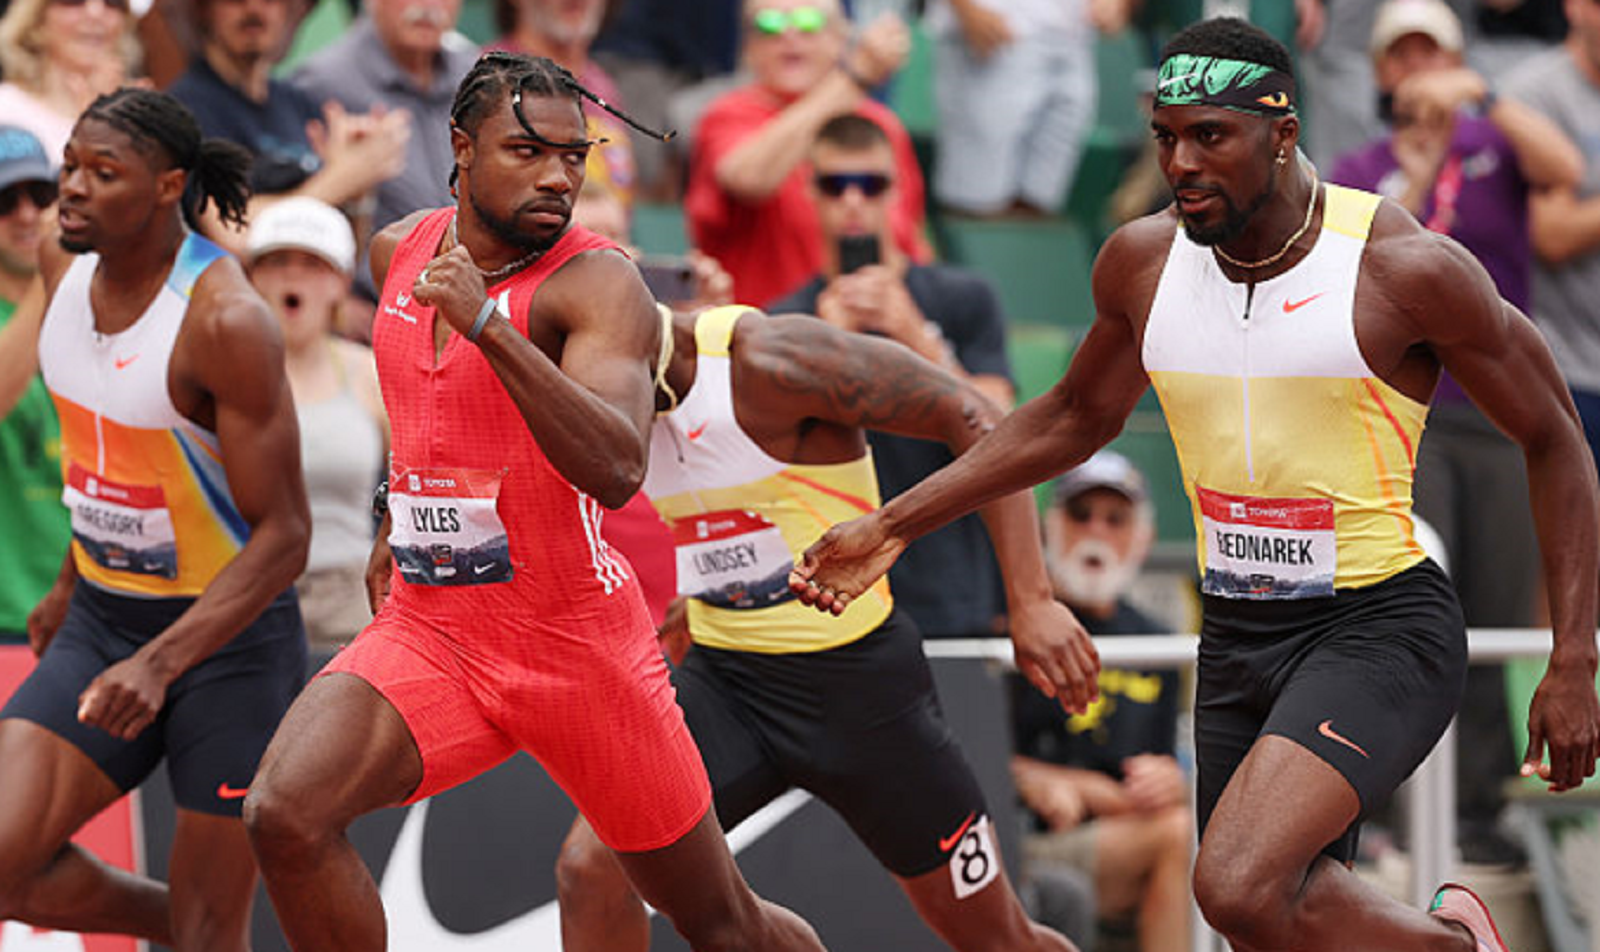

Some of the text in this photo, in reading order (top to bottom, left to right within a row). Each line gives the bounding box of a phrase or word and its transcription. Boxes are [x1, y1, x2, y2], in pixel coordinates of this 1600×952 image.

[411, 507, 461, 532] LYLES
[693, 541, 757, 575] LINDSEY
[960, 832, 988, 885] 8
